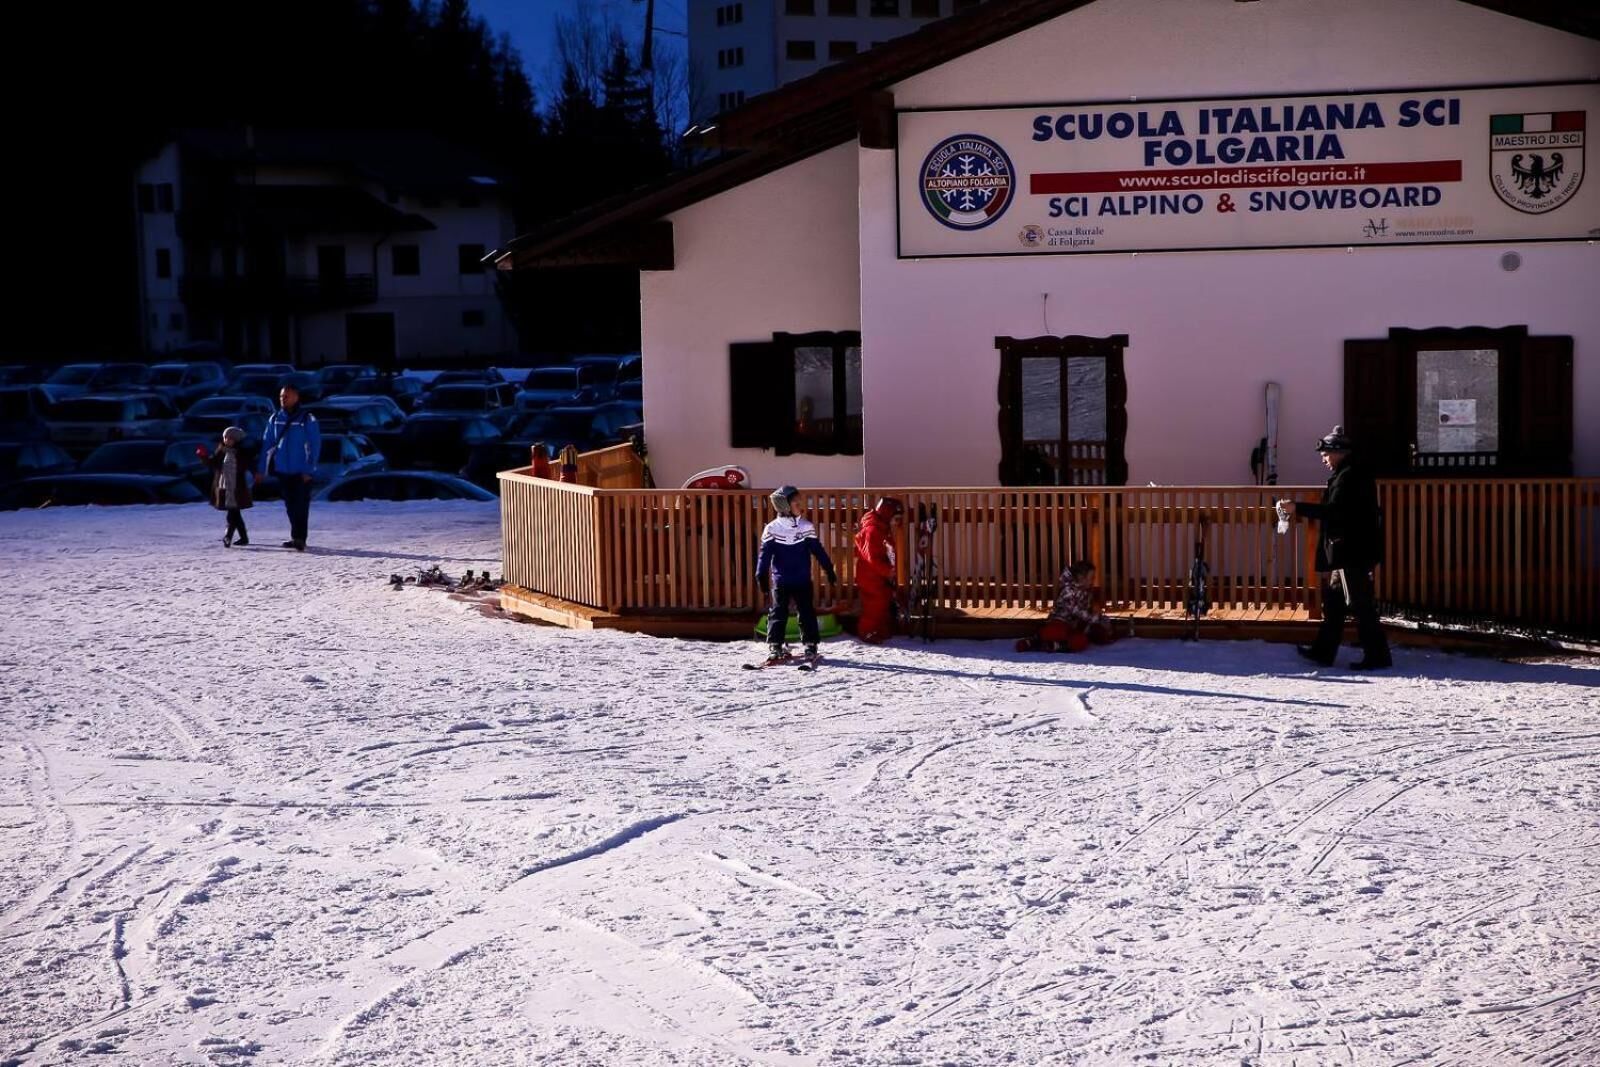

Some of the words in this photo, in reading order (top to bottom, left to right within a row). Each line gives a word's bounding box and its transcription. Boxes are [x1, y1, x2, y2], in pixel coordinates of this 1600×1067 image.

[1032, 110, 1184, 141] SCUOLA
[1200, 102, 1385, 134] ITALIANA
[1398, 98, 1460, 128] SCI
[1144, 134, 1345, 166] FOLGARIA
[1495, 135, 1546, 147] MAESTRO
[1549, 135, 1560, 145] DI
[1563, 134, 1580, 144] SCI
[930, 146, 957, 171] SCUOLA
[958, 142, 993, 157] ITALIANA
[992, 156, 1005, 170] SCI
[928, 178, 969, 188] ALTOPIANO
[970, 177, 1007, 187] FOLGARIA
[1119, 167, 1366, 188] www.scuoladiscifolgaria.it
[1049, 196, 1088, 217] SCI
[1098, 193, 1203, 216] ALPINO
[1216, 193, 1236, 213] &
[1249, 186, 1441, 212] SNOWBOARD
[1048, 227, 1073, 236] Cassa
[1075, 226, 1104, 236] Rurale
[1047, 237, 1057, 246] di
[1059, 237, 1095, 248] Folgaria
